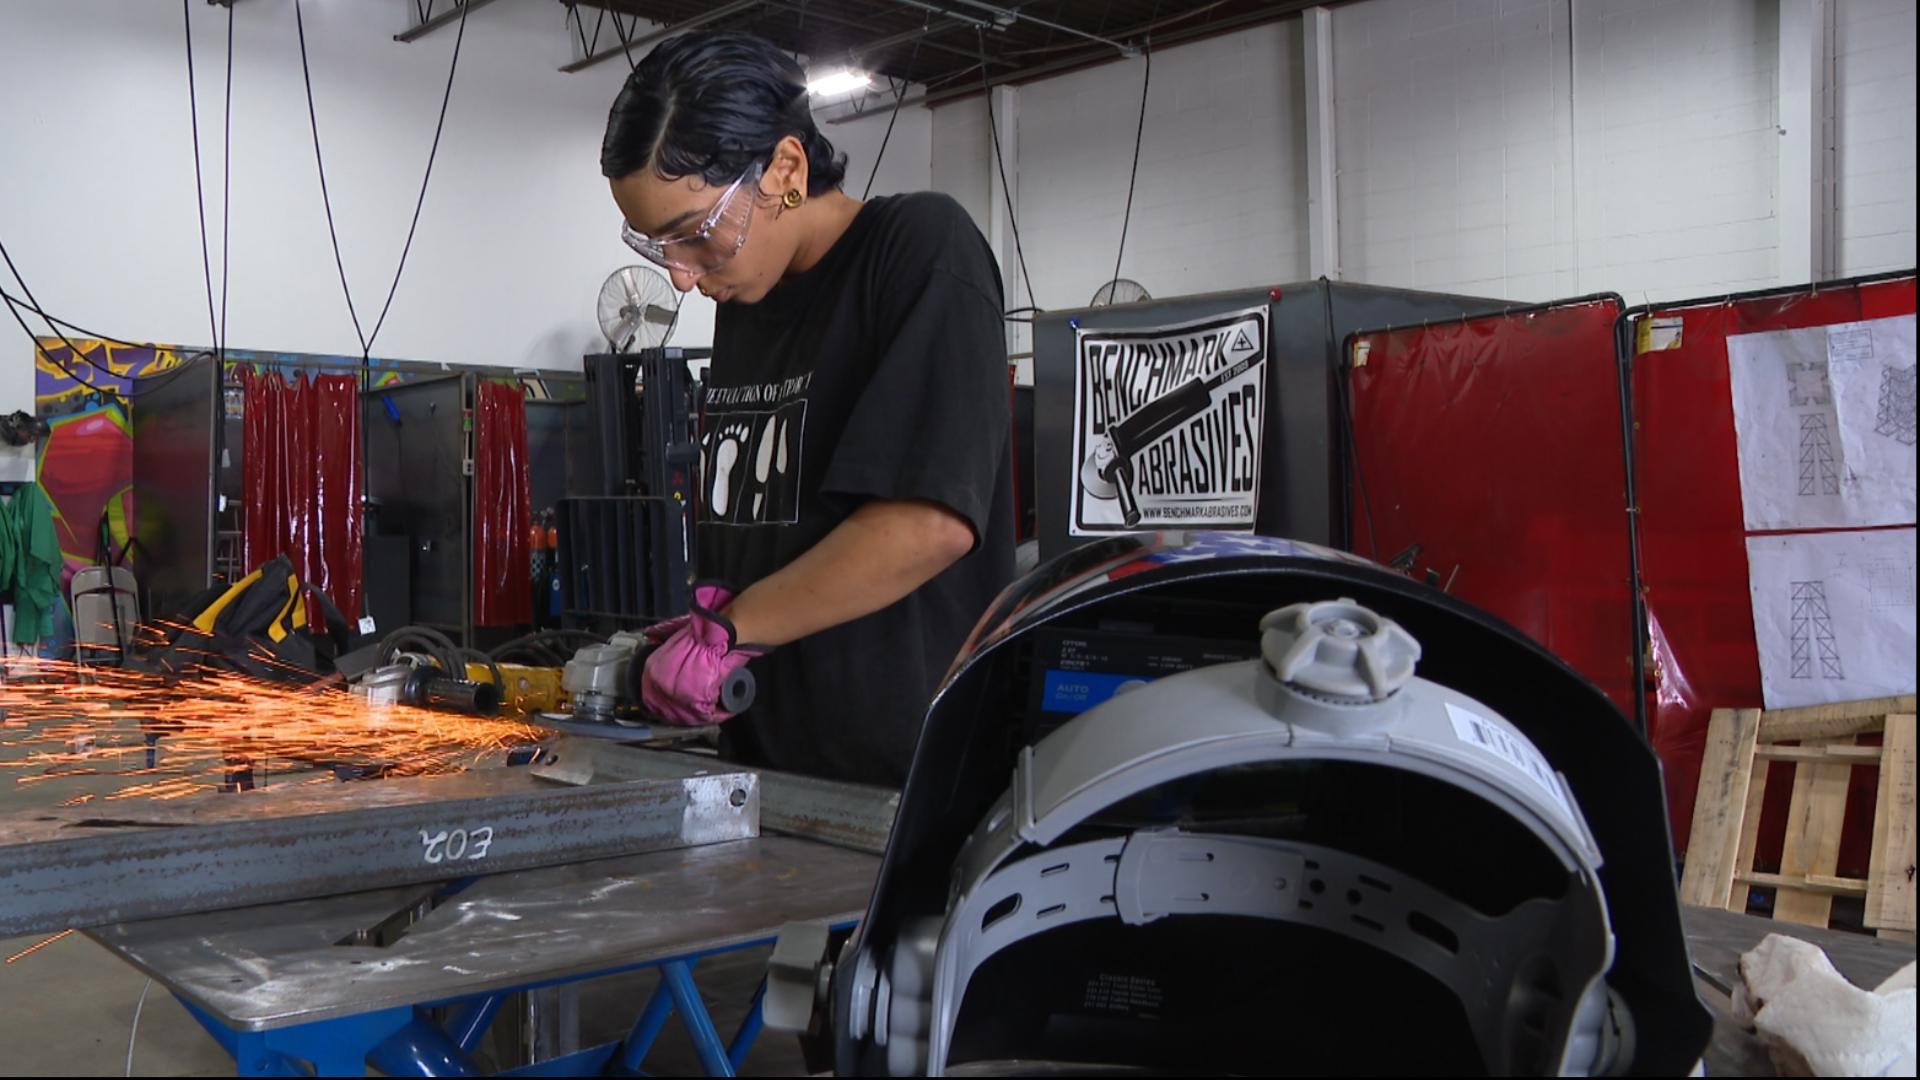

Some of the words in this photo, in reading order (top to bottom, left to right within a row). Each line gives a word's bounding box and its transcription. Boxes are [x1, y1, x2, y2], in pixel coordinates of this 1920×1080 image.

[1088, 330, 1232, 435] BENCHMARK
[1139, 384, 1256, 495] ABRASIVES
[1056, 683, 1090, 694] AUTO
[418, 826, 494, 864] E02
